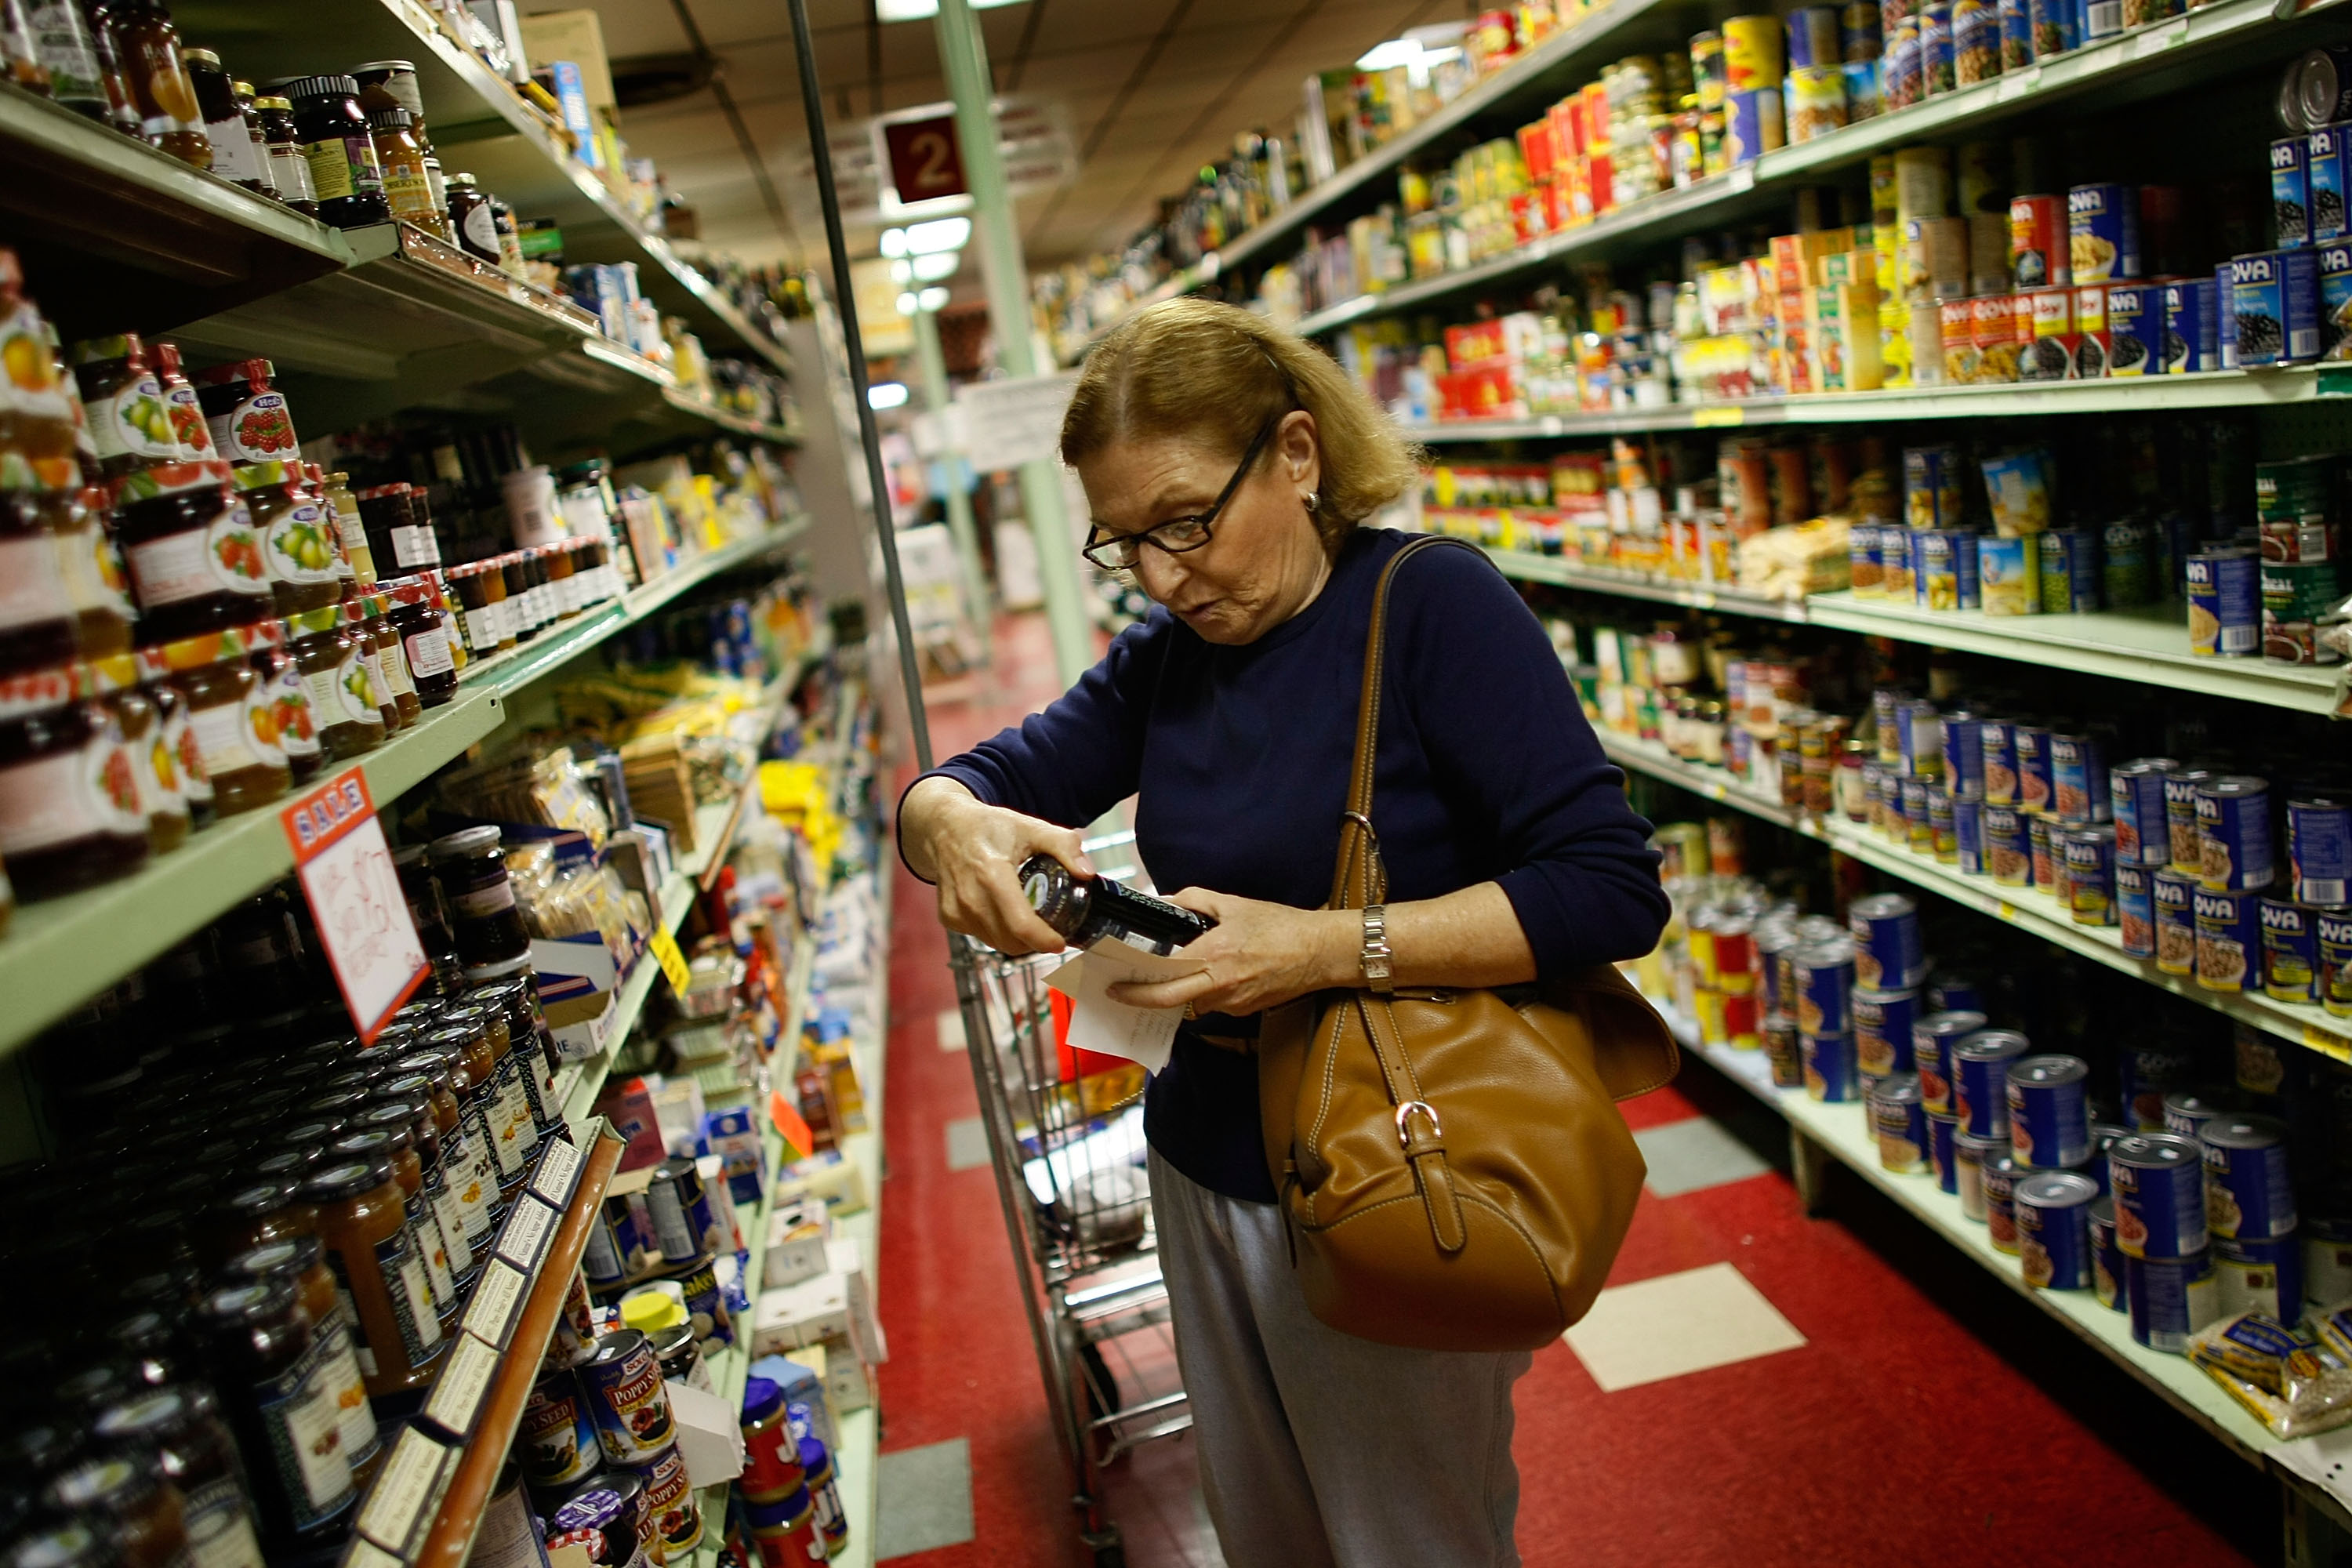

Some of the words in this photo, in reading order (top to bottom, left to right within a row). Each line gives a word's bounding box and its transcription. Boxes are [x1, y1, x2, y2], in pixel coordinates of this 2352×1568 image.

[2310, 132, 2332, 154] YA
[910, 132, 955, 188] 2
[2271, 146, 2293, 167] YA
[2232, 260, 2270, 282] OYA
[2321, 249, 2350, 272] YA
[2187, 563, 2209, 583] YA
[295, 777, 366, 848] SALE
[2196, 797, 2218, 818] YA
[2194, 894, 2234, 918] OYA
[2261, 905, 2300, 931] OYA
[2319, 919, 2352, 943] OYA
[2111, 1164, 2135, 1185] YA
[614, 1378, 650, 1406] POPPY
[539, 1403, 570, 1426] SEED
